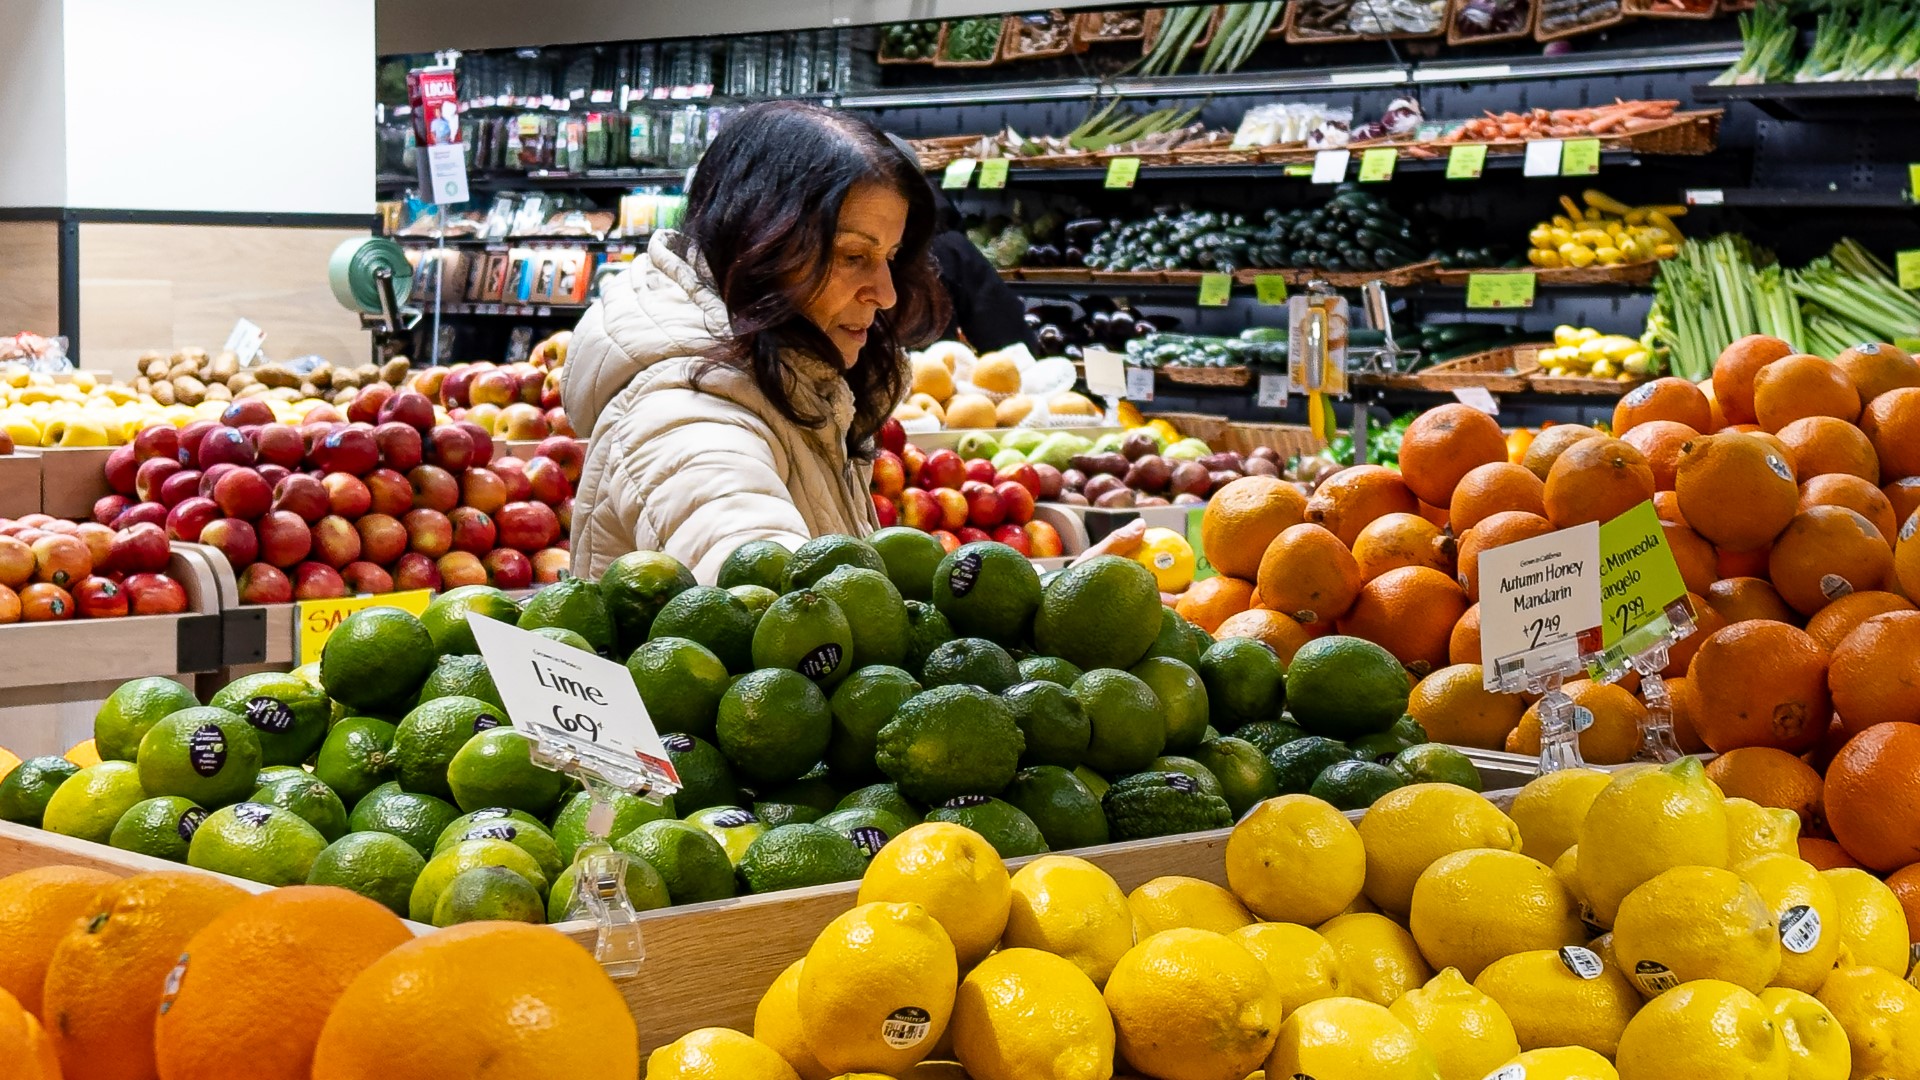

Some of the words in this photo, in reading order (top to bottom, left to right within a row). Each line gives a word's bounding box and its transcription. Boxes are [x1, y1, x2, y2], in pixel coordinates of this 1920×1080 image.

[424, 81, 456, 98] LOCAL
[1606, 534, 1659, 572] Minneola
[1499, 571, 1544, 594] Autumn
[1545, 560, 1584, 582] Honey
[1513, 585, 1572, 613] Mandarin
[531, 659, 609, 706] Lime
